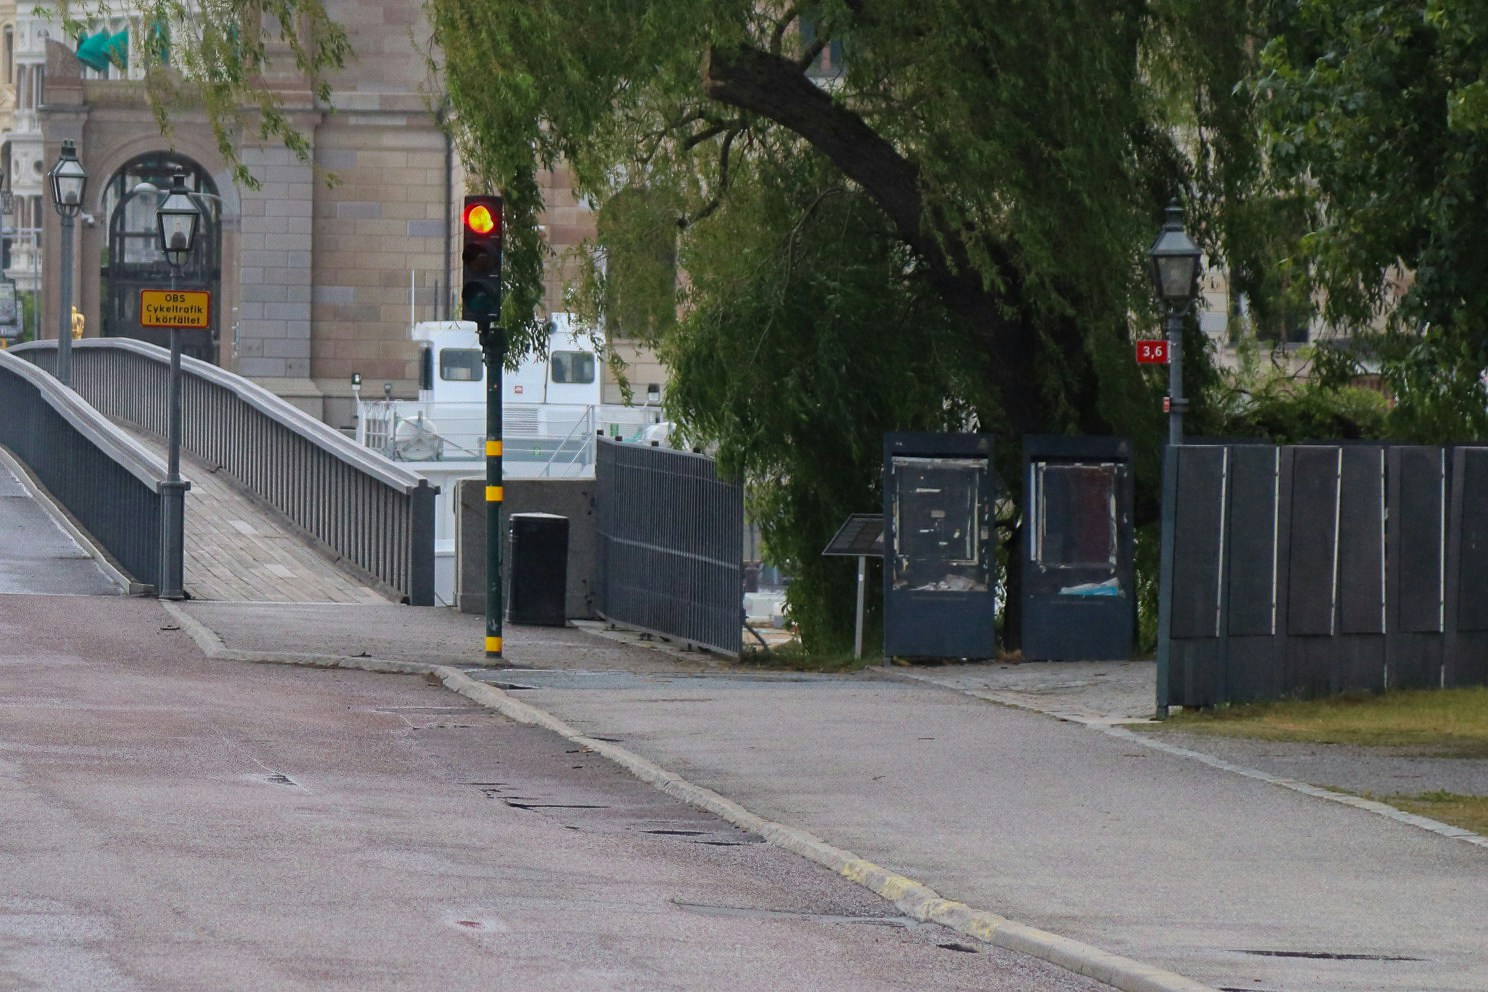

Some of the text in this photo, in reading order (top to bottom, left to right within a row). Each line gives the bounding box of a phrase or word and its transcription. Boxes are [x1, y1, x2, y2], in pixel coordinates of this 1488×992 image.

[165, 294, 186, 303] OBS
[146, 304, 203, 314] Cykeltrafik
[155, 315, 201, 325] körfältet
[1143, 345, 1163, 360] 3,6
